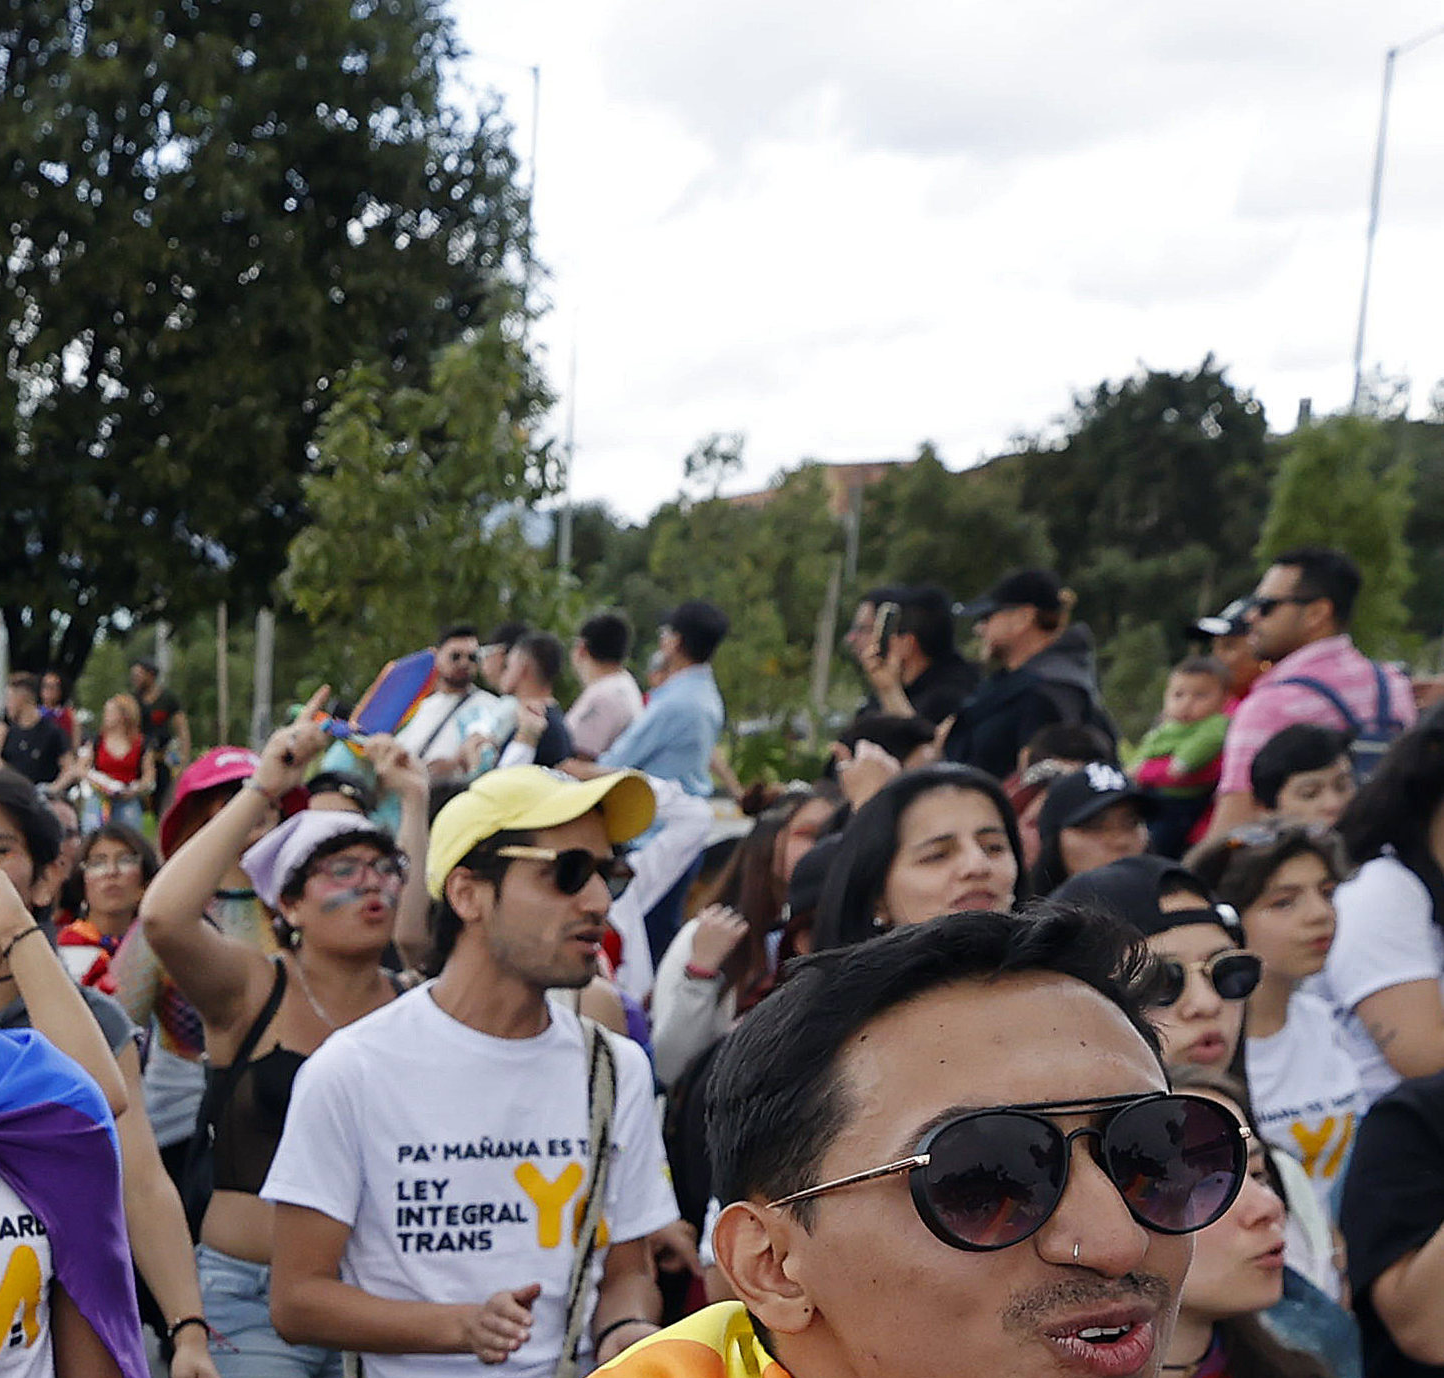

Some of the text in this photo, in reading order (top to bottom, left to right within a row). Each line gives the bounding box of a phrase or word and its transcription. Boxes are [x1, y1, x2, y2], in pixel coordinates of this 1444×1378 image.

[398, 1144, 437, 1163] PA'
[444, 1136, 540, 1161] MAÑANA
[549, 1139, 571, 1156] ES
[397, 1179, 449, 1201] LEY
[397, 1203, 528, 1227] INTEGRAL
[397, 1230, 492, 1252] TRANS
